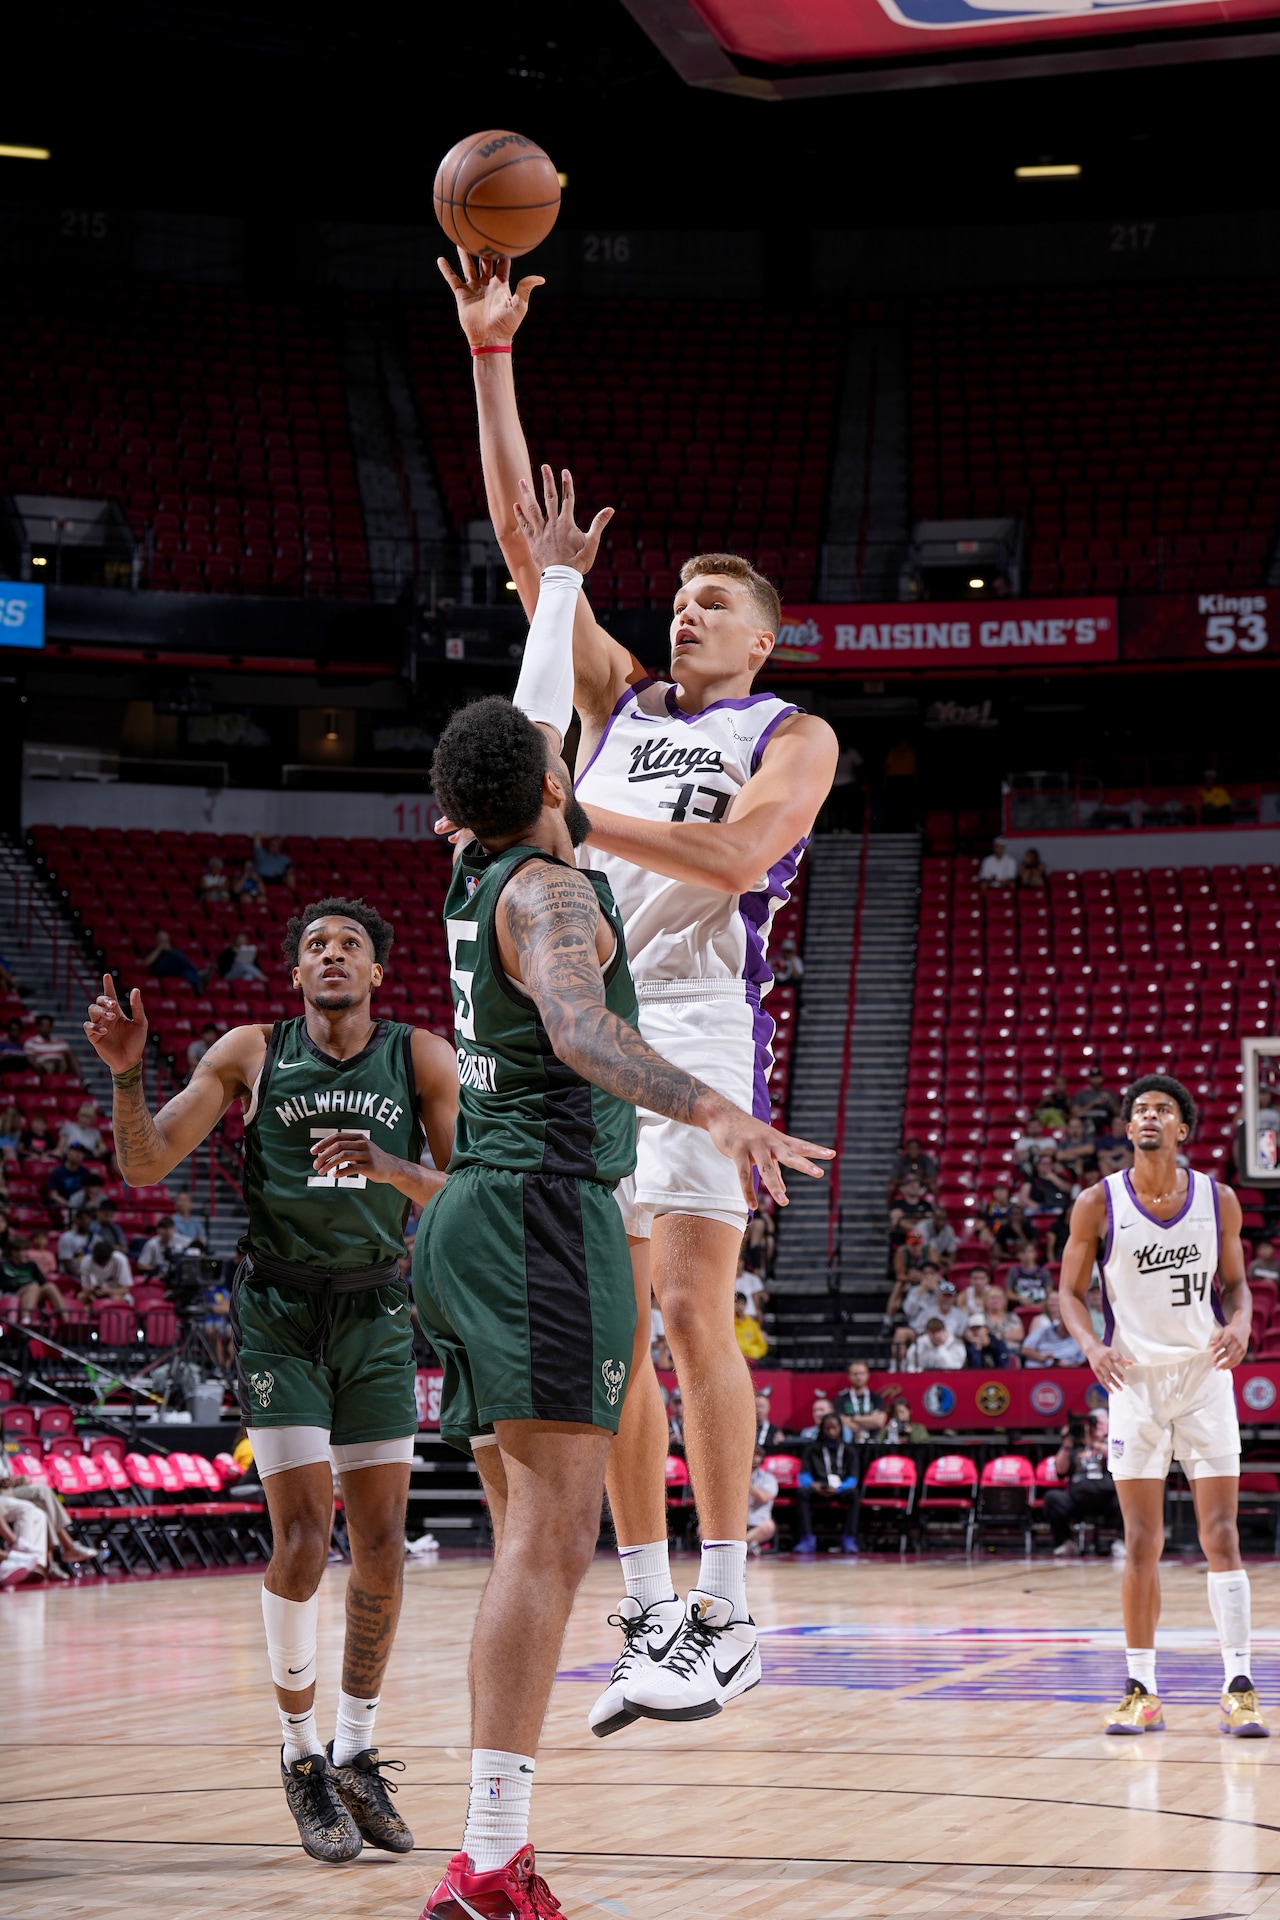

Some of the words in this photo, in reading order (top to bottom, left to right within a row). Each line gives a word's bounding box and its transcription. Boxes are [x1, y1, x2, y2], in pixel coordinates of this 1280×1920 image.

[60, 209, 108, 239] 215
[1109, 222, 1156, 251] 217
[582, 235, 630, 263] 216
[1198, 594, 1267, 615] Kings
[776, 618, 823, 647] ne's
[834, 622, 971, 651] RAISING
[1205, 614, 1268, 654] 53
[628, 737, 724, 783] Kings
[557, 890, 576, 898] YOU
[561, 901, 588, 911] DREAM
[275, 1090, 404, 1130] MILWAUKEE
[1133, 1243, 1202, 1275] Kings
[1169, 1271, 1208, 1307] 34
